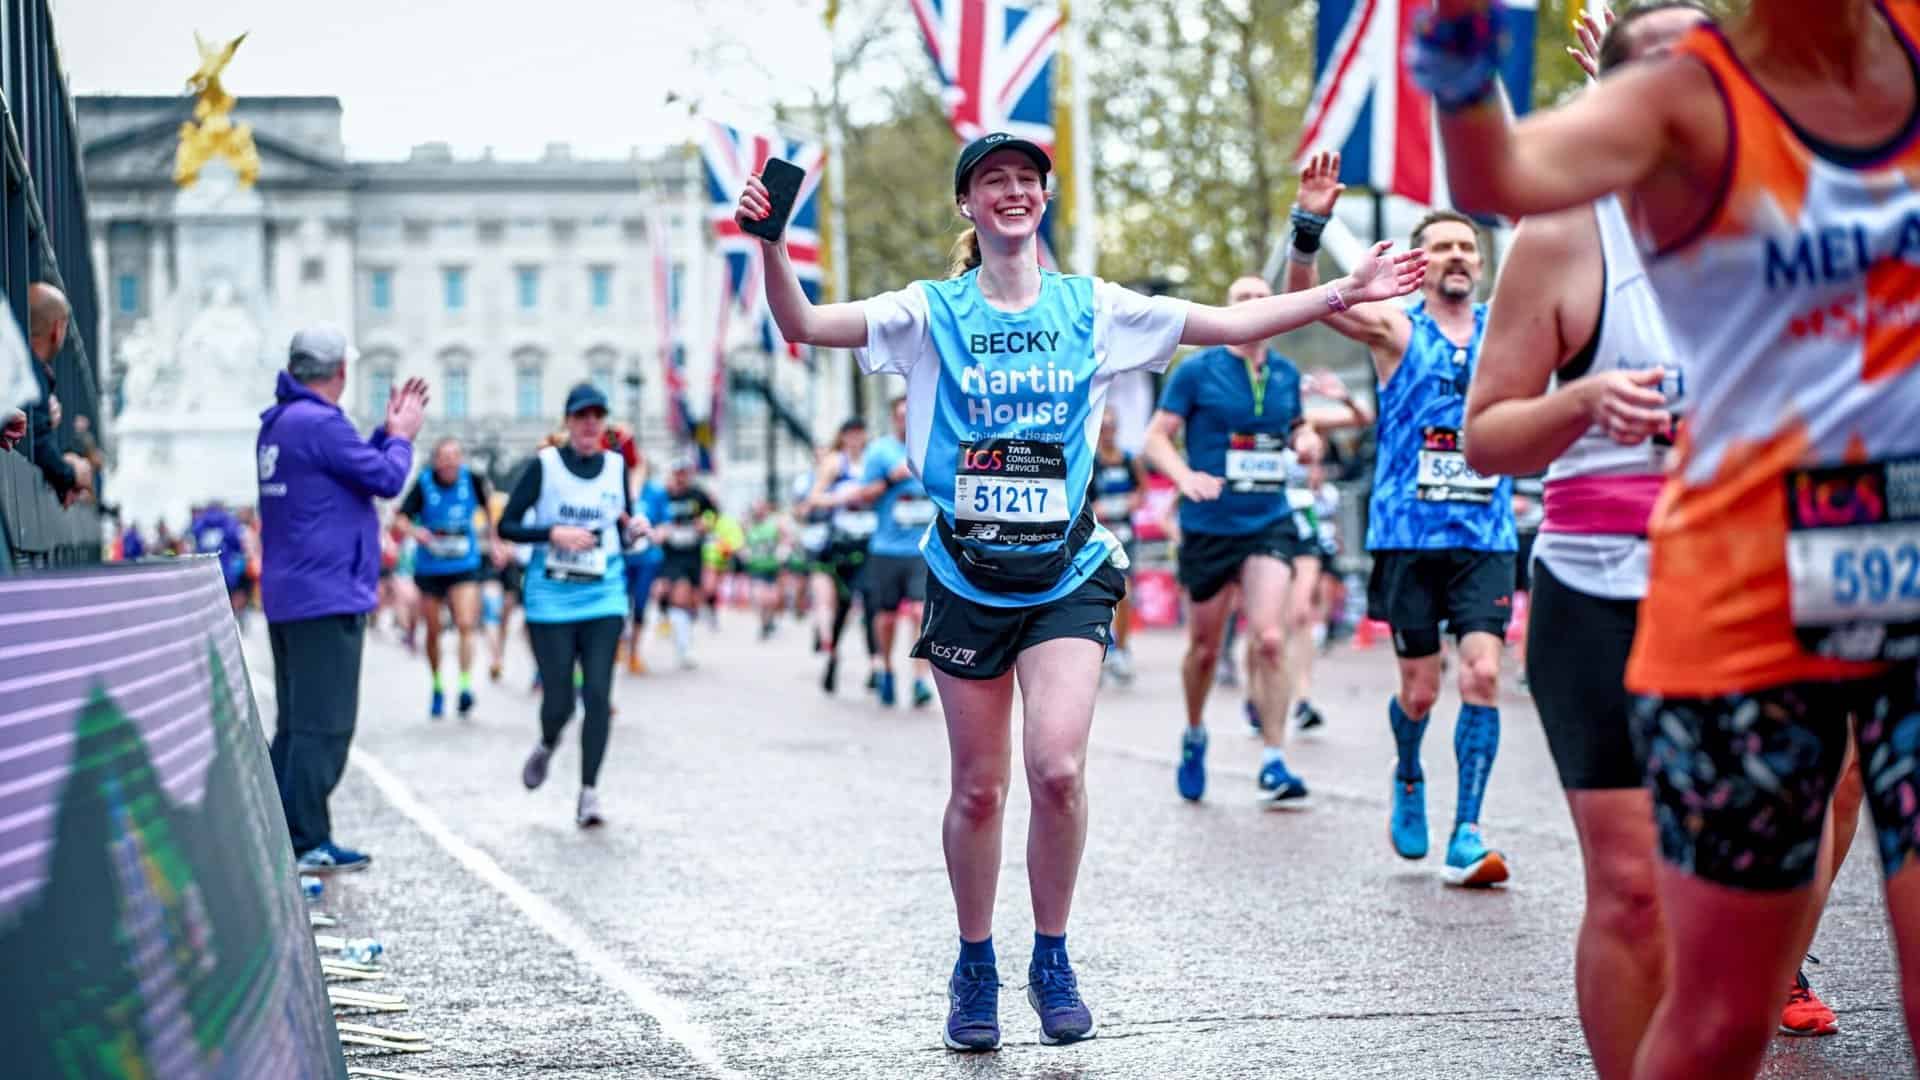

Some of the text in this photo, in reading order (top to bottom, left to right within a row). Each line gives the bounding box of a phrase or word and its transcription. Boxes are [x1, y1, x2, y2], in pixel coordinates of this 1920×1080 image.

[970, 331, 1060, 354] BECKY
[960, 362, 1075, 395] Martin
[966, 397, 1070, 428] House
[963, 447, 1003, 471] tcs
[1007, 446, 1032, 455] TATA
[1005, 463, 1040, 474] SERVICES
[1006, 455, 1061, 467] CONSULTANCY
[973, 485, 1049, 514] 51217
[999, 533, 1019, 542] new
[930, 641, 952, 658] tcs
